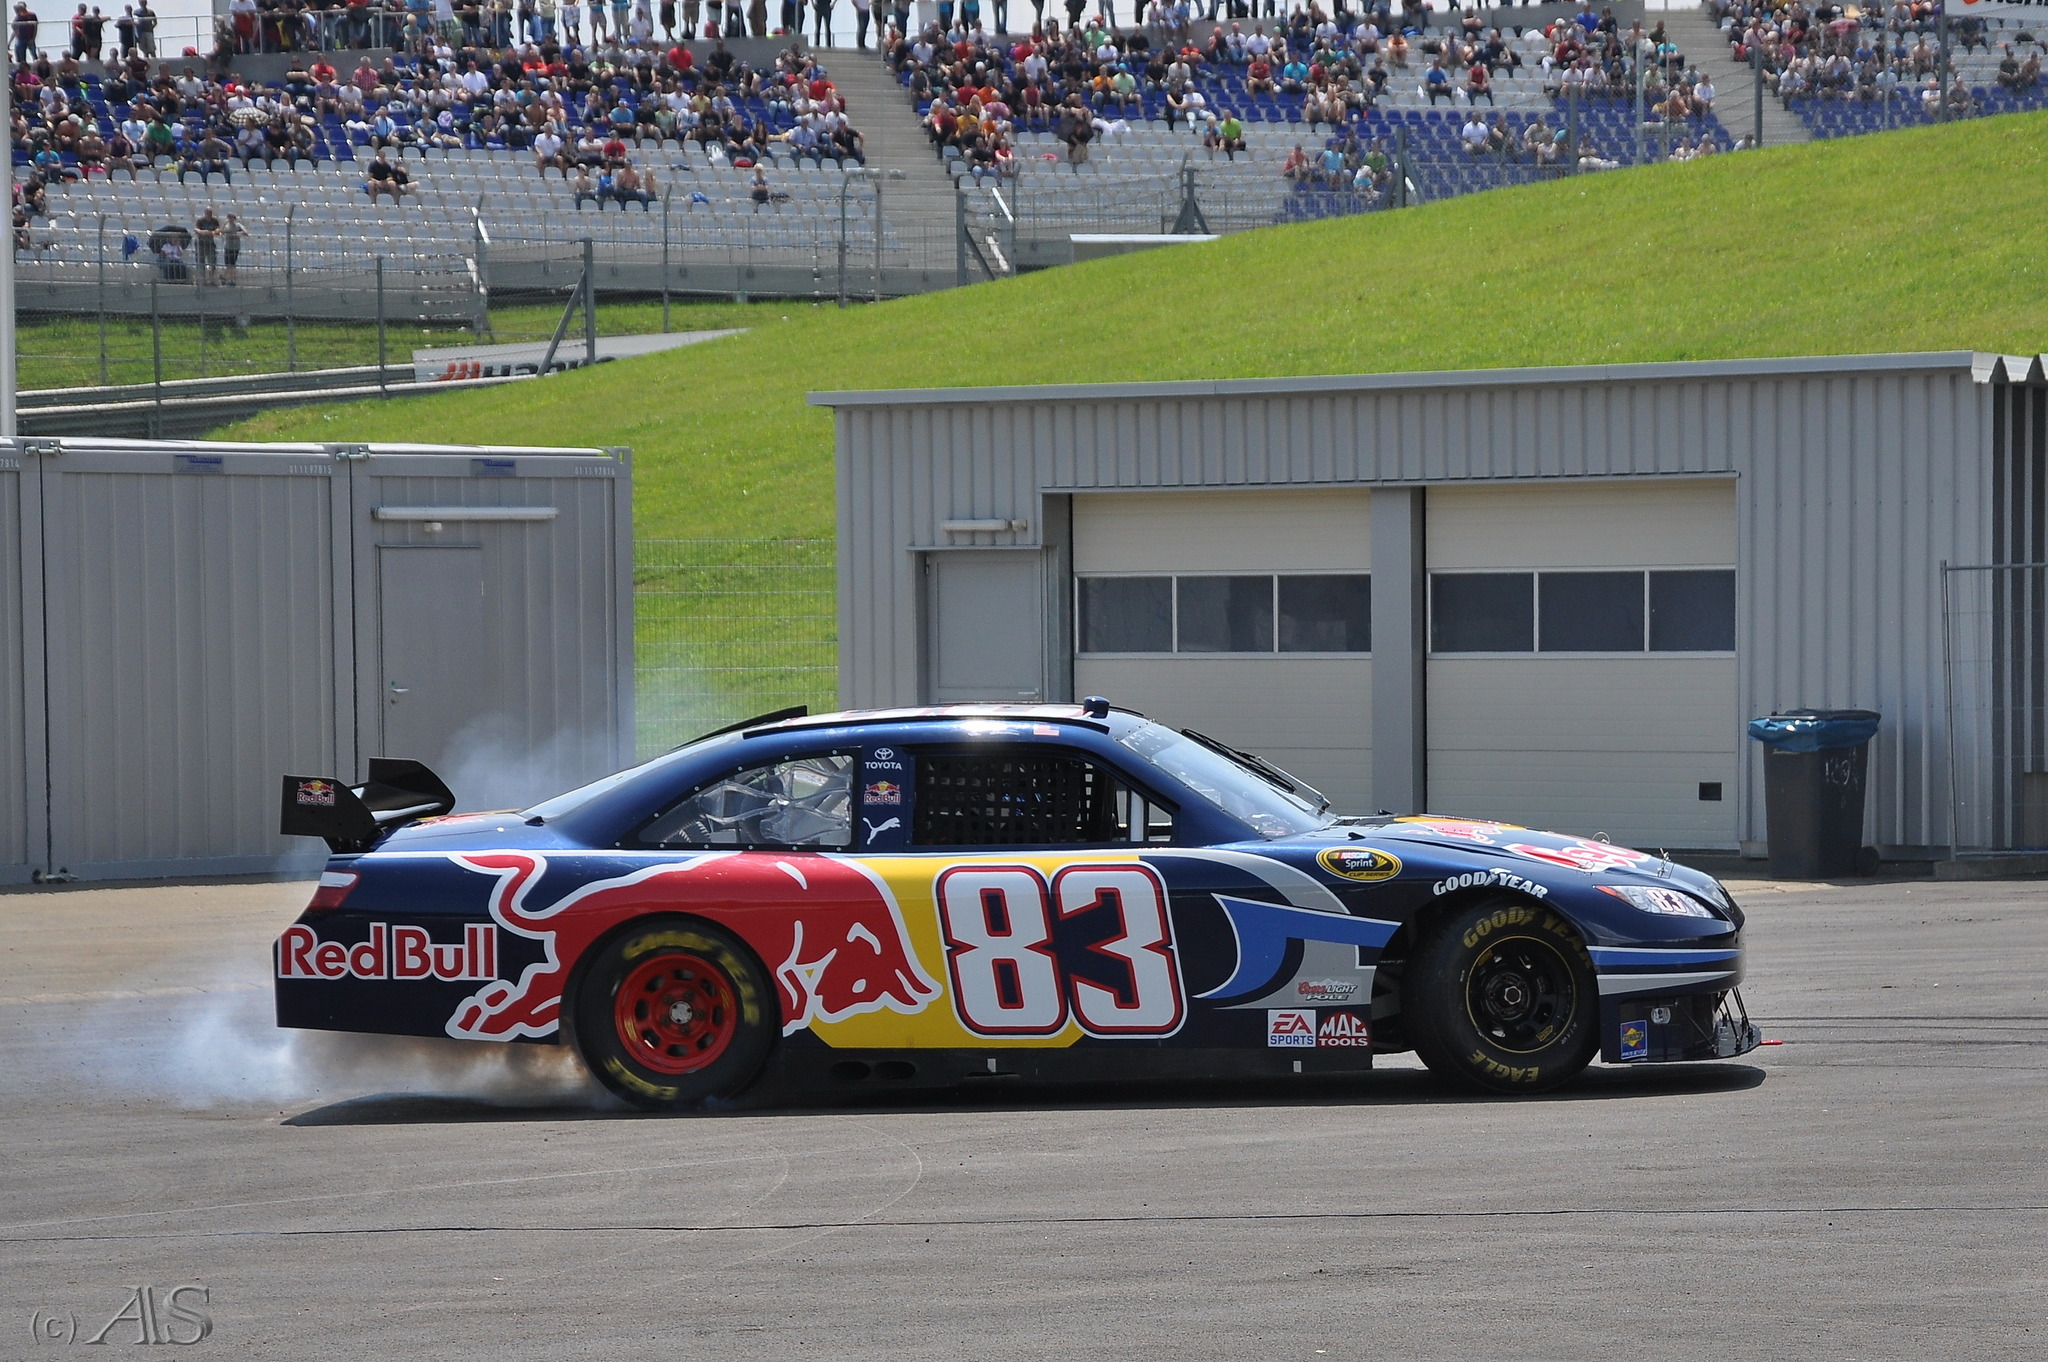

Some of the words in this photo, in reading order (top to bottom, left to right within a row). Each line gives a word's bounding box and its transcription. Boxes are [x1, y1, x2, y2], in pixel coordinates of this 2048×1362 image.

[864, 761, 902, 770] TOYOTA
[297, 792, 316, 803] Red
[316, 793, 335, 804] Bull
[864, 793, 883, 803] Red
[884, 793, 901, 803] Bull
[1345, 859, 1373, 869] Sprint
[1646, 889, 1688, 913] 83
[278, 922, 387, 979] Red
[392, 923, 497, 981] Bull
[932, 861, 1187, 1039] 83
[1326, 985, 1358, 994] LIGHT
[1271, 1013, 1312, 1034] EA
[1319, 1014, 1368, 1036] MAC
[1270, 1035, 1314, 1045] SPORTS
[1319, 1038, 1368, 1046] TOOLS
[1467, 1049, 1539, 1082] EAGLE
